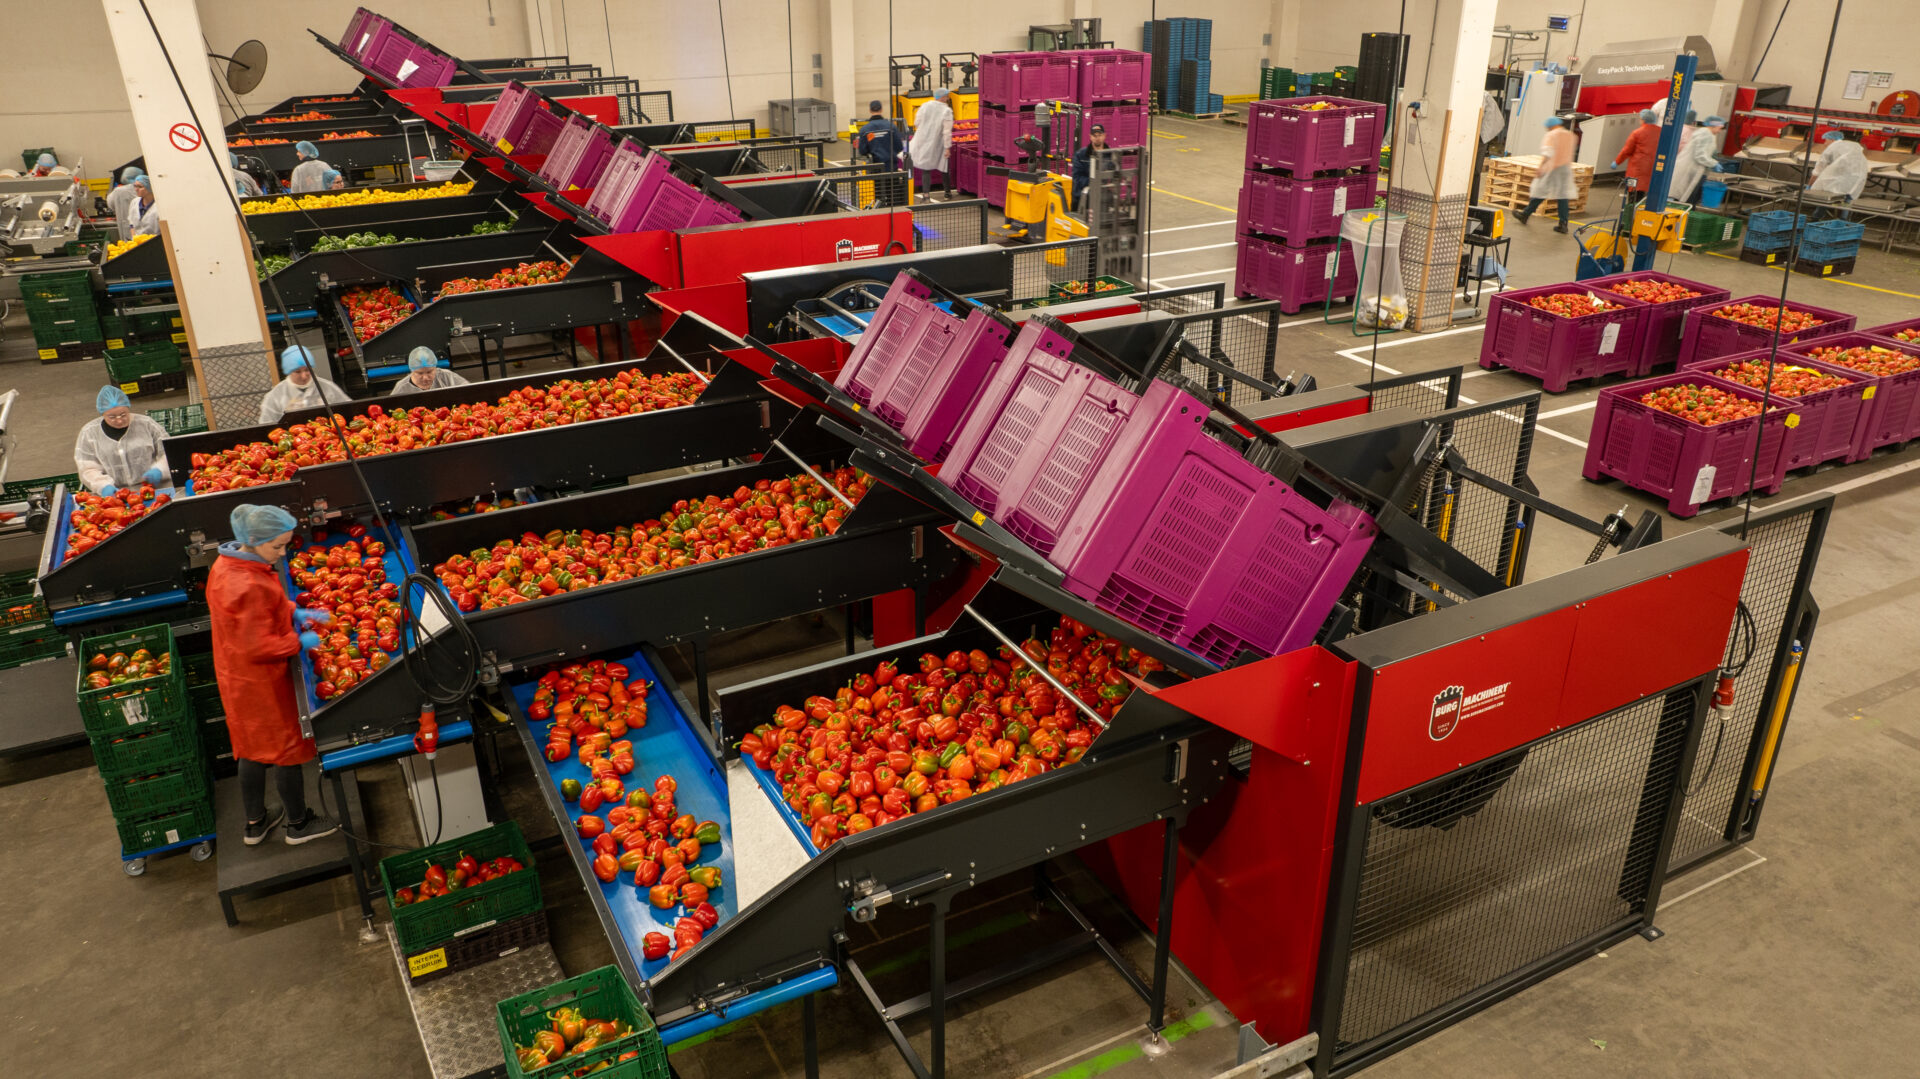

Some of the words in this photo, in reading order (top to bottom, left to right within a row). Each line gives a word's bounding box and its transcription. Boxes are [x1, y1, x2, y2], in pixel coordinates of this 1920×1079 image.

[1598, 65, 1624, 75] EasyPack
[1625, 64, 1664, 72] Technologies
[1463, 682, 1509, 707] MACHINERY
[1435, 701, 1458, 717] BURG
[413, 953, 439, 965] INTERN
